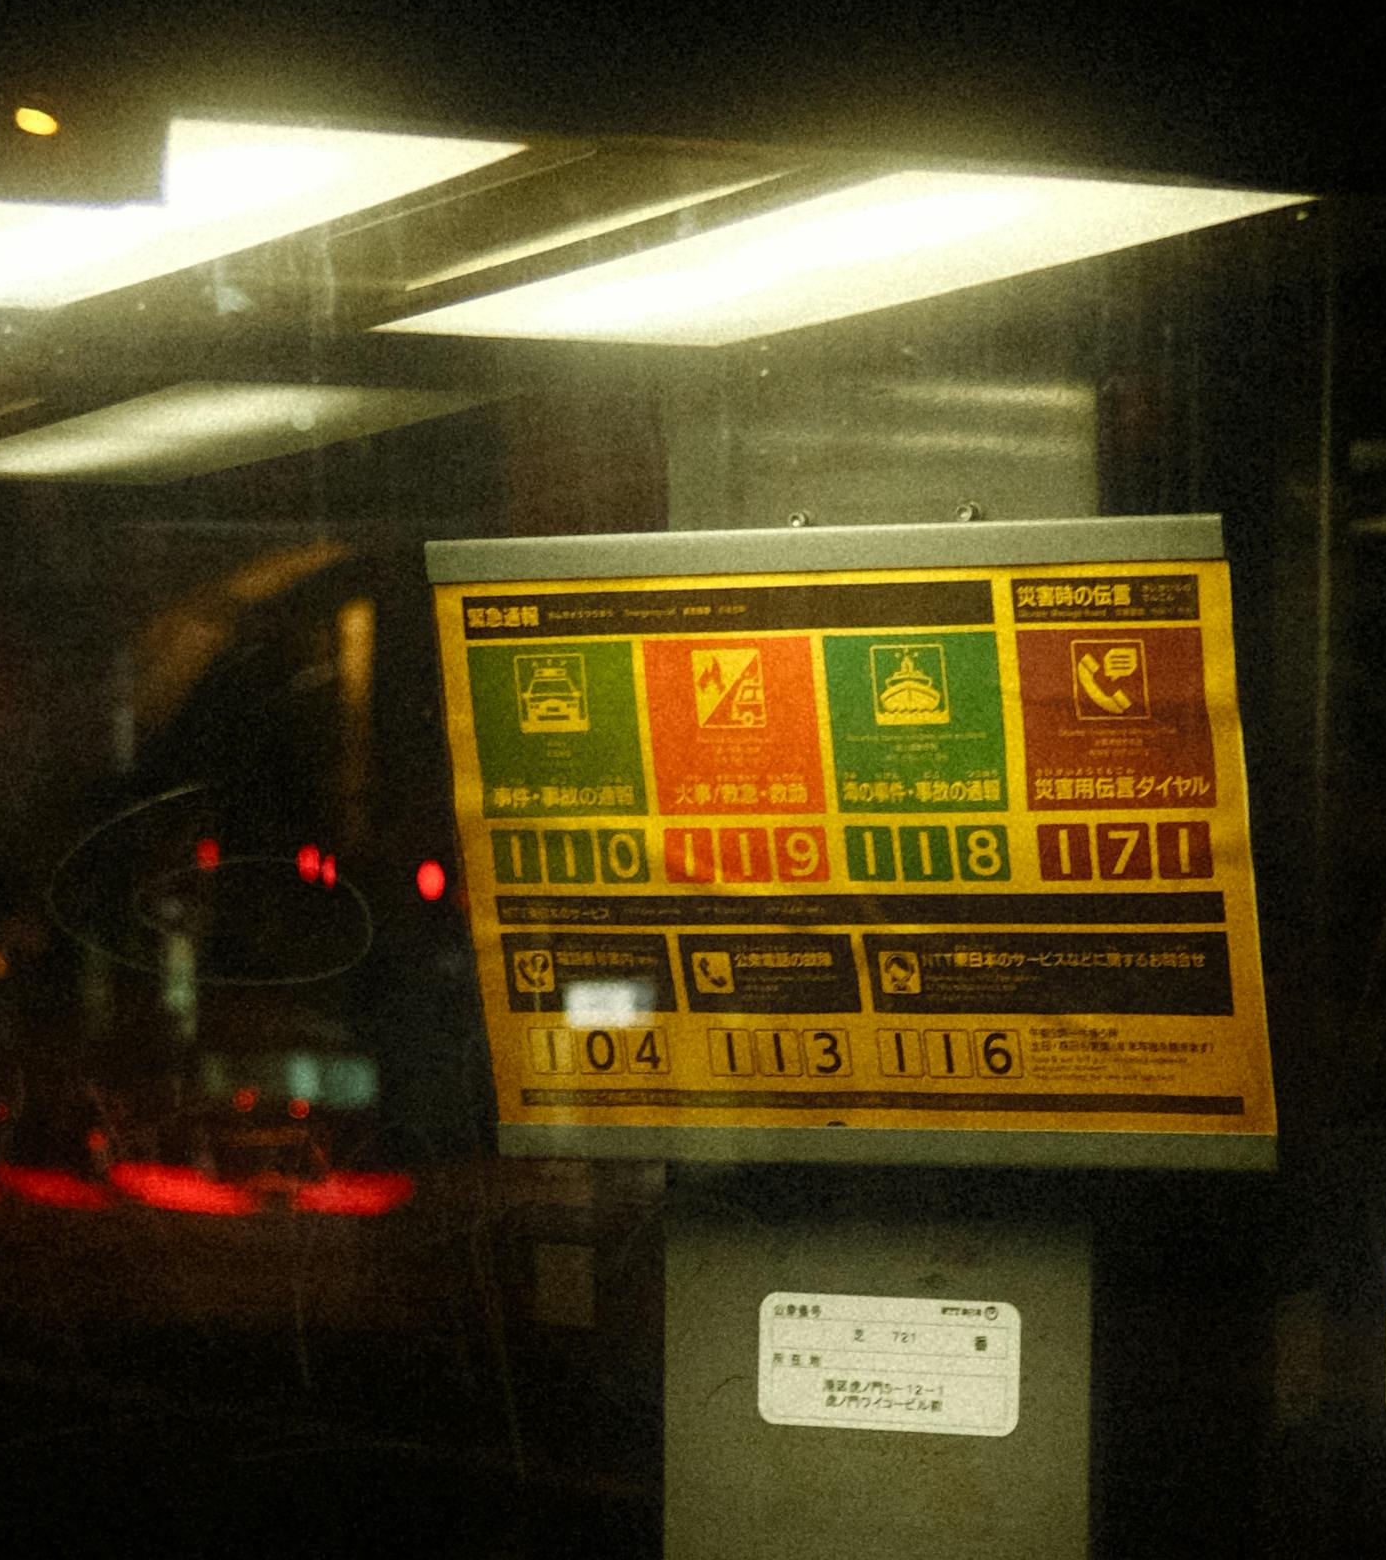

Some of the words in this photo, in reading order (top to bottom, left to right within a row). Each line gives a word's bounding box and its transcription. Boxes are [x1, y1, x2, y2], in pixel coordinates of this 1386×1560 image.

[1016, 584, 1132, 607] 災害時の伝言
[1034, 773, 1211, 800] 災害用伝言ダイヤル
[510, 833, 642, 878] 110
[684, 832, 819, 876] 119
[864, 830, 1002, 876] 118
[1058, 828, 1190, 874] 171
[548, 1030, 662, 1072] 104
[725, 1031, 843, 1073] 113
[893, 1032, 1013, 1075] 116
